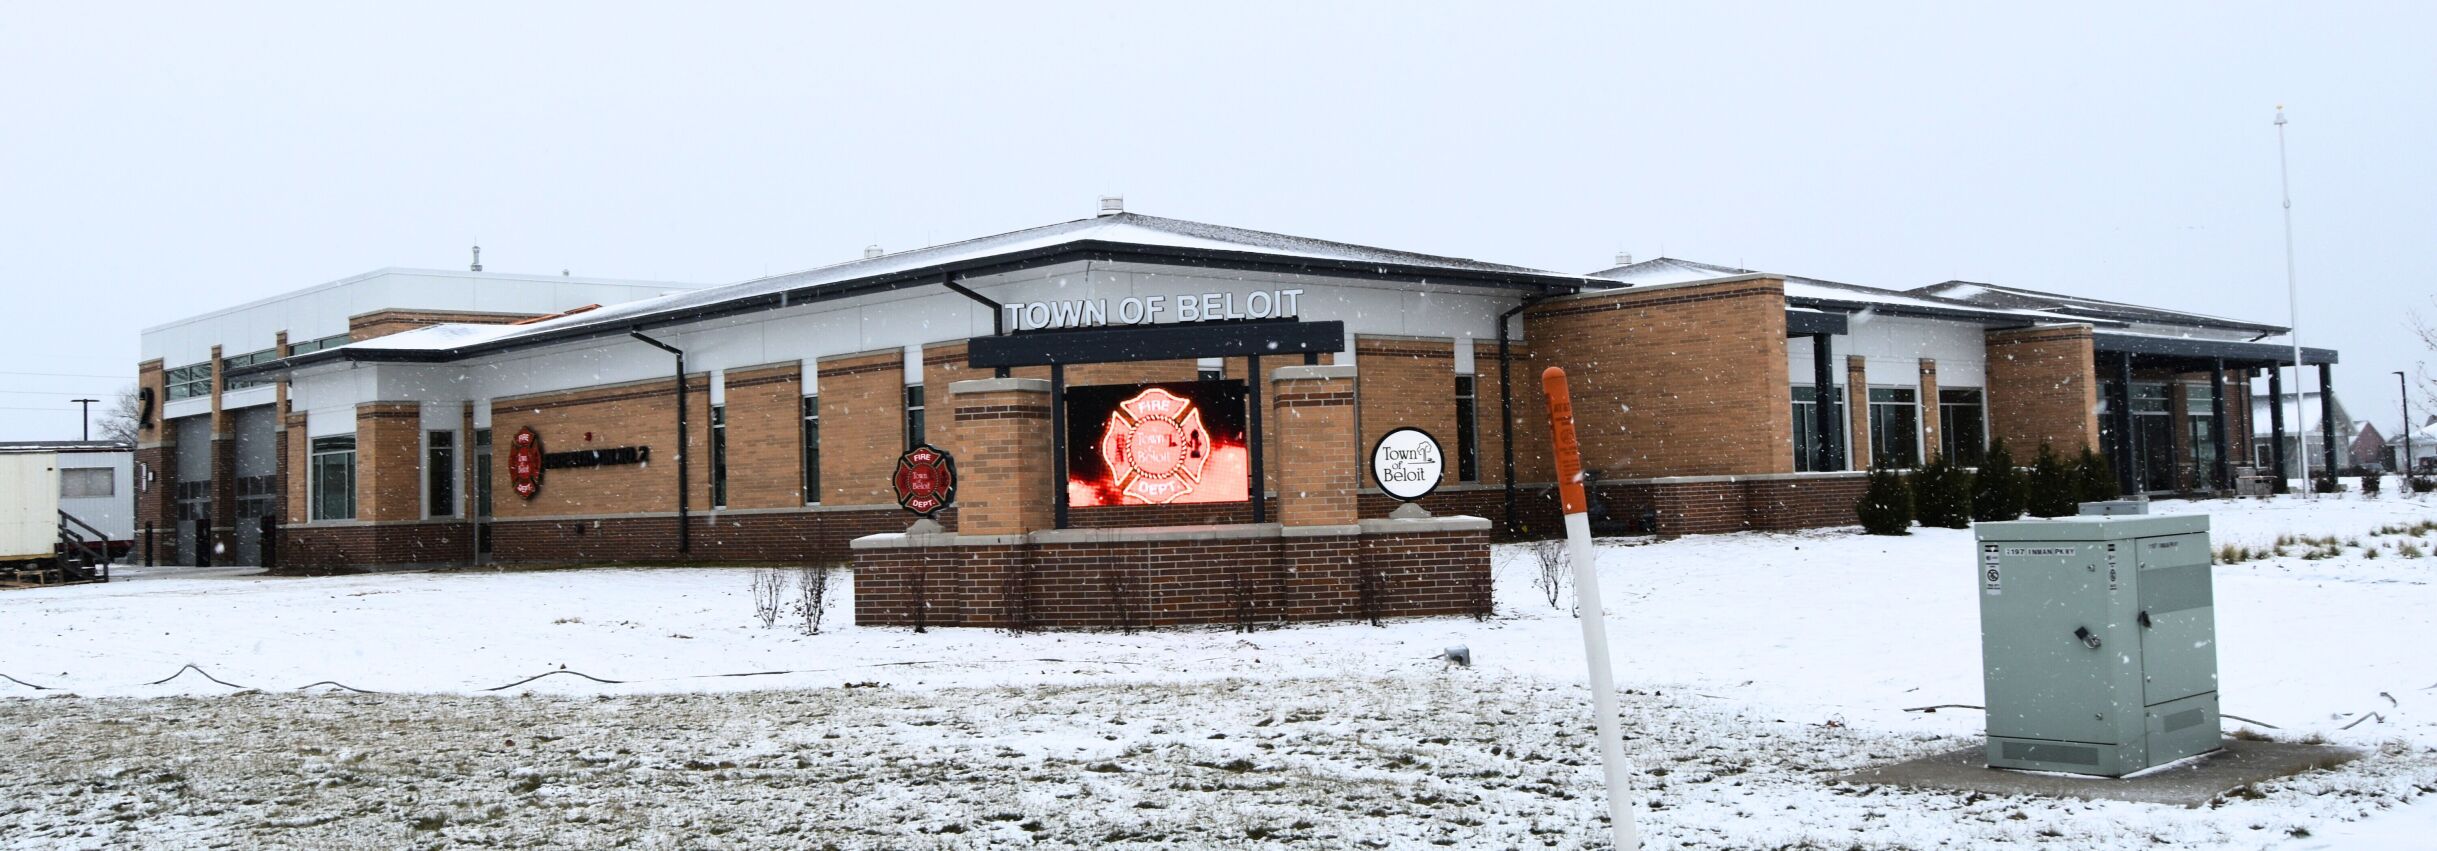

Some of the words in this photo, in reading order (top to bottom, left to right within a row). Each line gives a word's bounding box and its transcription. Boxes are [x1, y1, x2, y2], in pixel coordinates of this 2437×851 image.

[1004, 299, 1107, 330] TOWN
[1118, 295, 1165, 325] OF
[1177, 289, 1304, 323] BELOIT
[1138, 400, 1170, 414] FIRE
[1137, 432, 1165, 446] Town
[913, 453, 931, 462] FIRE
[1382, 446, 1418, 461] Town
[1392, 461, 1404, 470] of
[912, 471, 928, 479] Town
[1383, 467, 1426, 482] Beloit
[912, 482, 931, 490] Beloit
[912, 499, 936, 508] DEPT.
